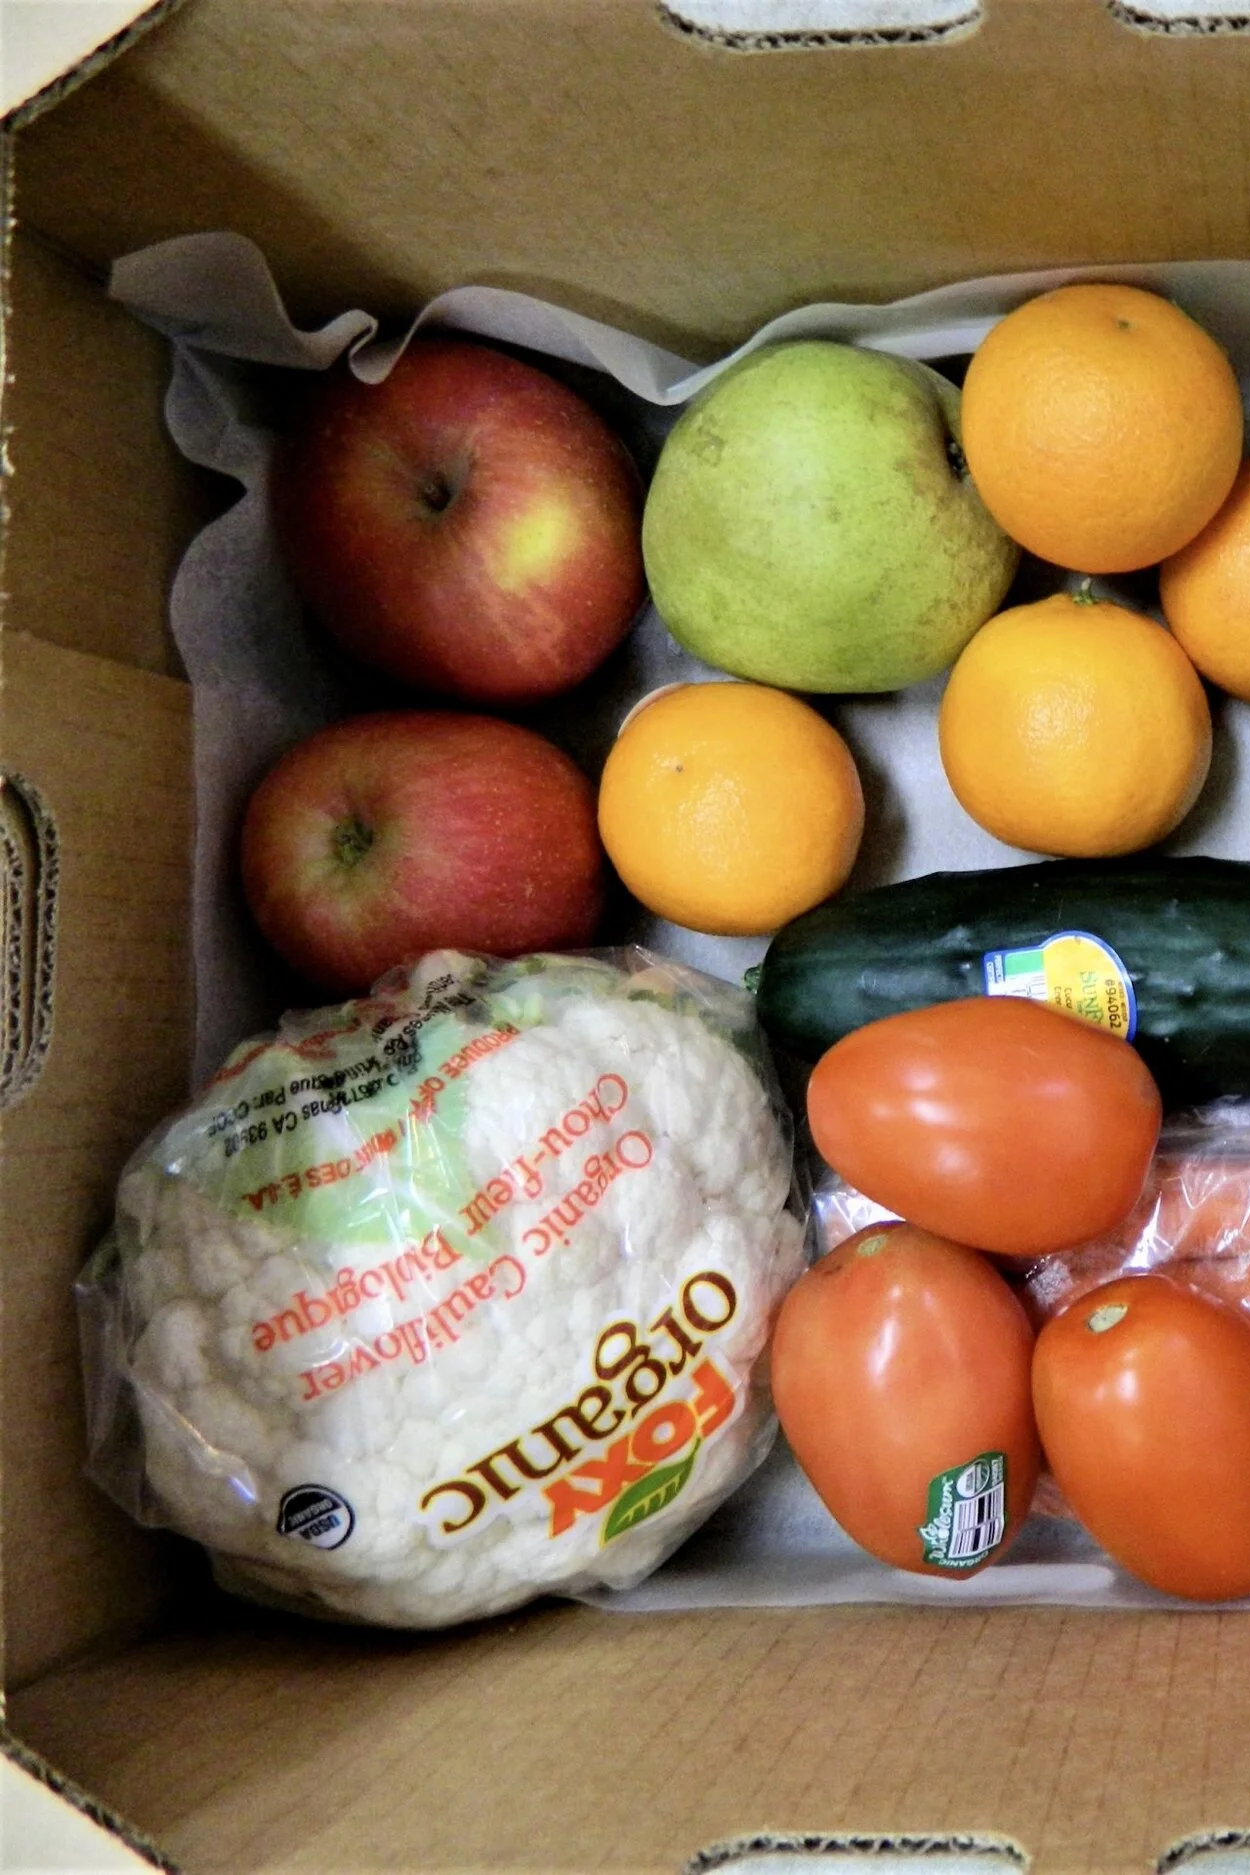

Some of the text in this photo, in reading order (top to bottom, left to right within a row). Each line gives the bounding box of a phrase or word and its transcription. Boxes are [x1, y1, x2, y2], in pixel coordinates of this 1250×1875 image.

[251, 1223, 464, 1353] Biologique
[297, 1129, 654, 1401] Organic Cauliflower
[542, 1358, 736, 1539] FOXY
[299, 1514, 341, 1541] USDA
